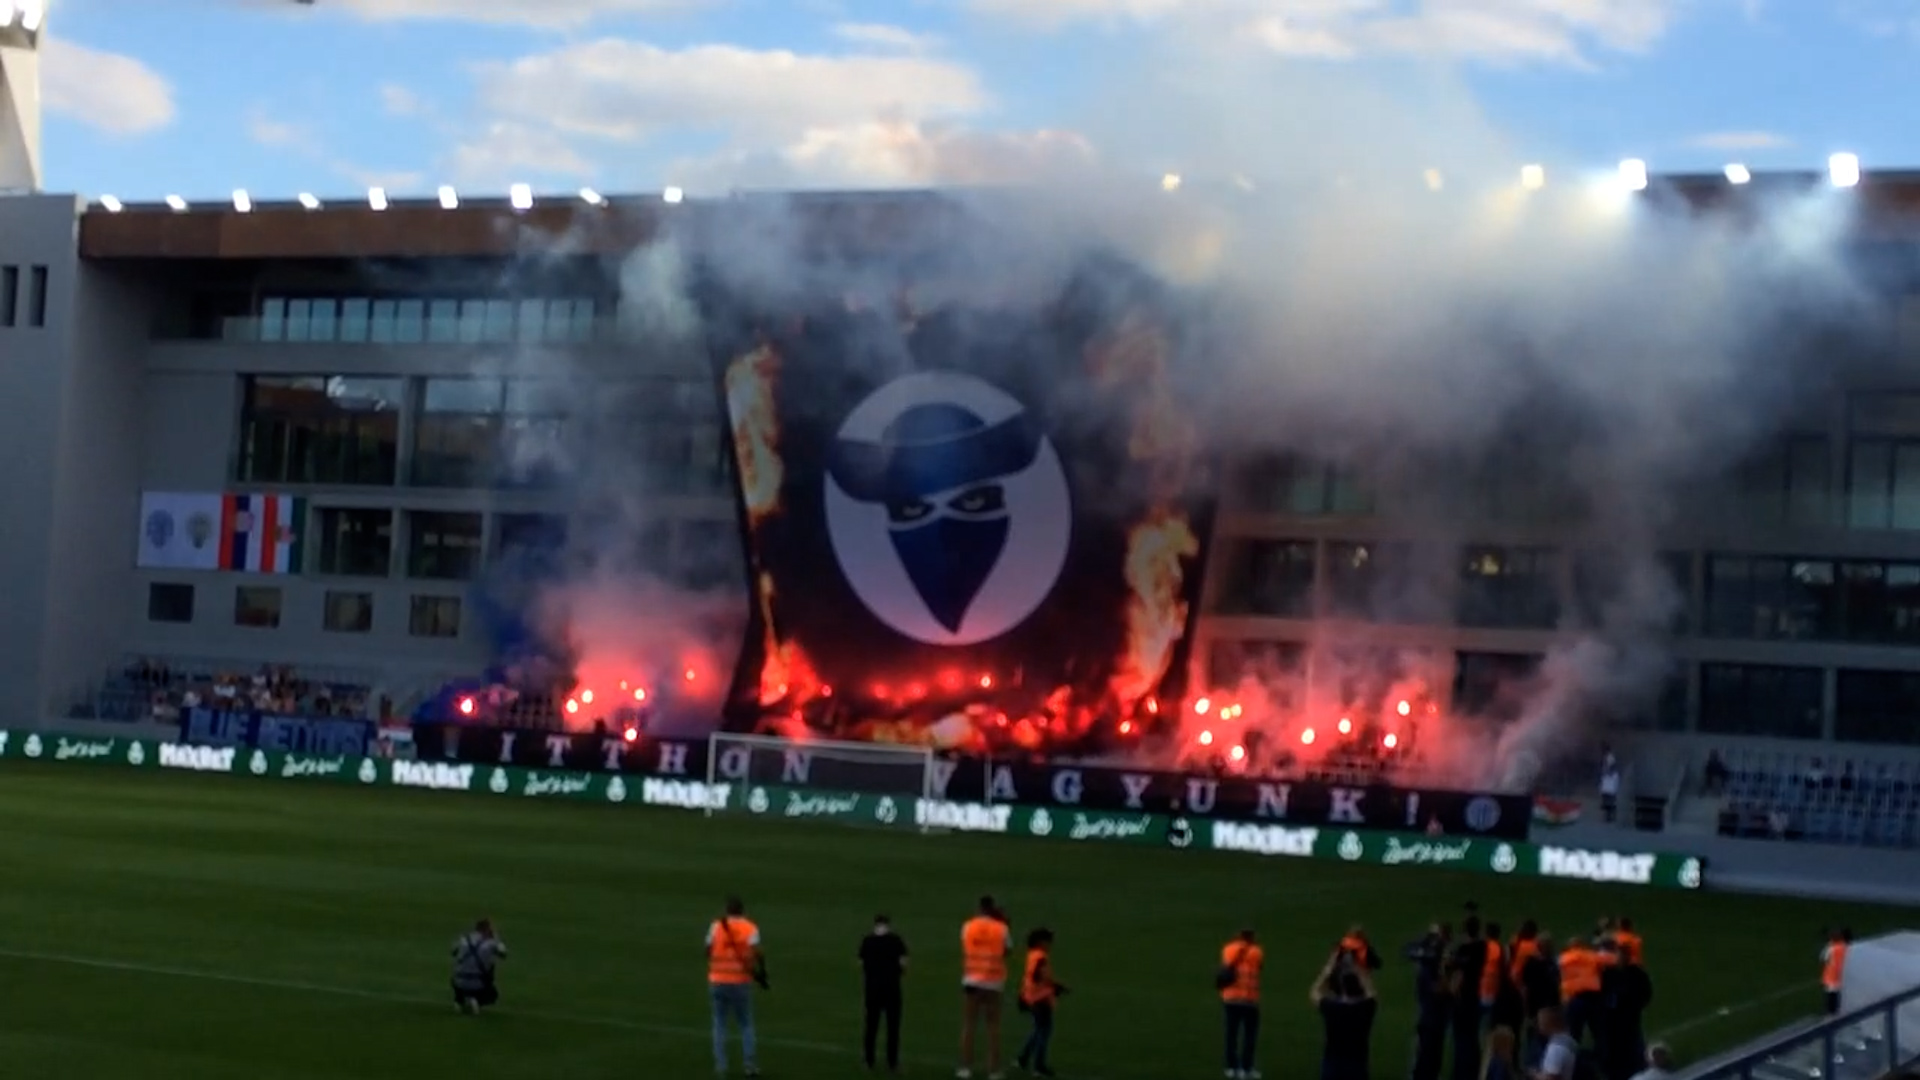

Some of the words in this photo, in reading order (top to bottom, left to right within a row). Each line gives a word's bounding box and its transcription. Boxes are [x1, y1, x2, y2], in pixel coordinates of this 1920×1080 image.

[159, 742, 235, 771] MAXBET
[500, 732, 811, 783] ITTHON
[392, 759, 473, 789] MAXBET
[643, 777, 731, 808] MAXBET
[916, 799, 1011, 831] MAXBET
[1213, 821, 1317, 855] MAXBET
[1540, 846, 1655, 882] MAXBET
